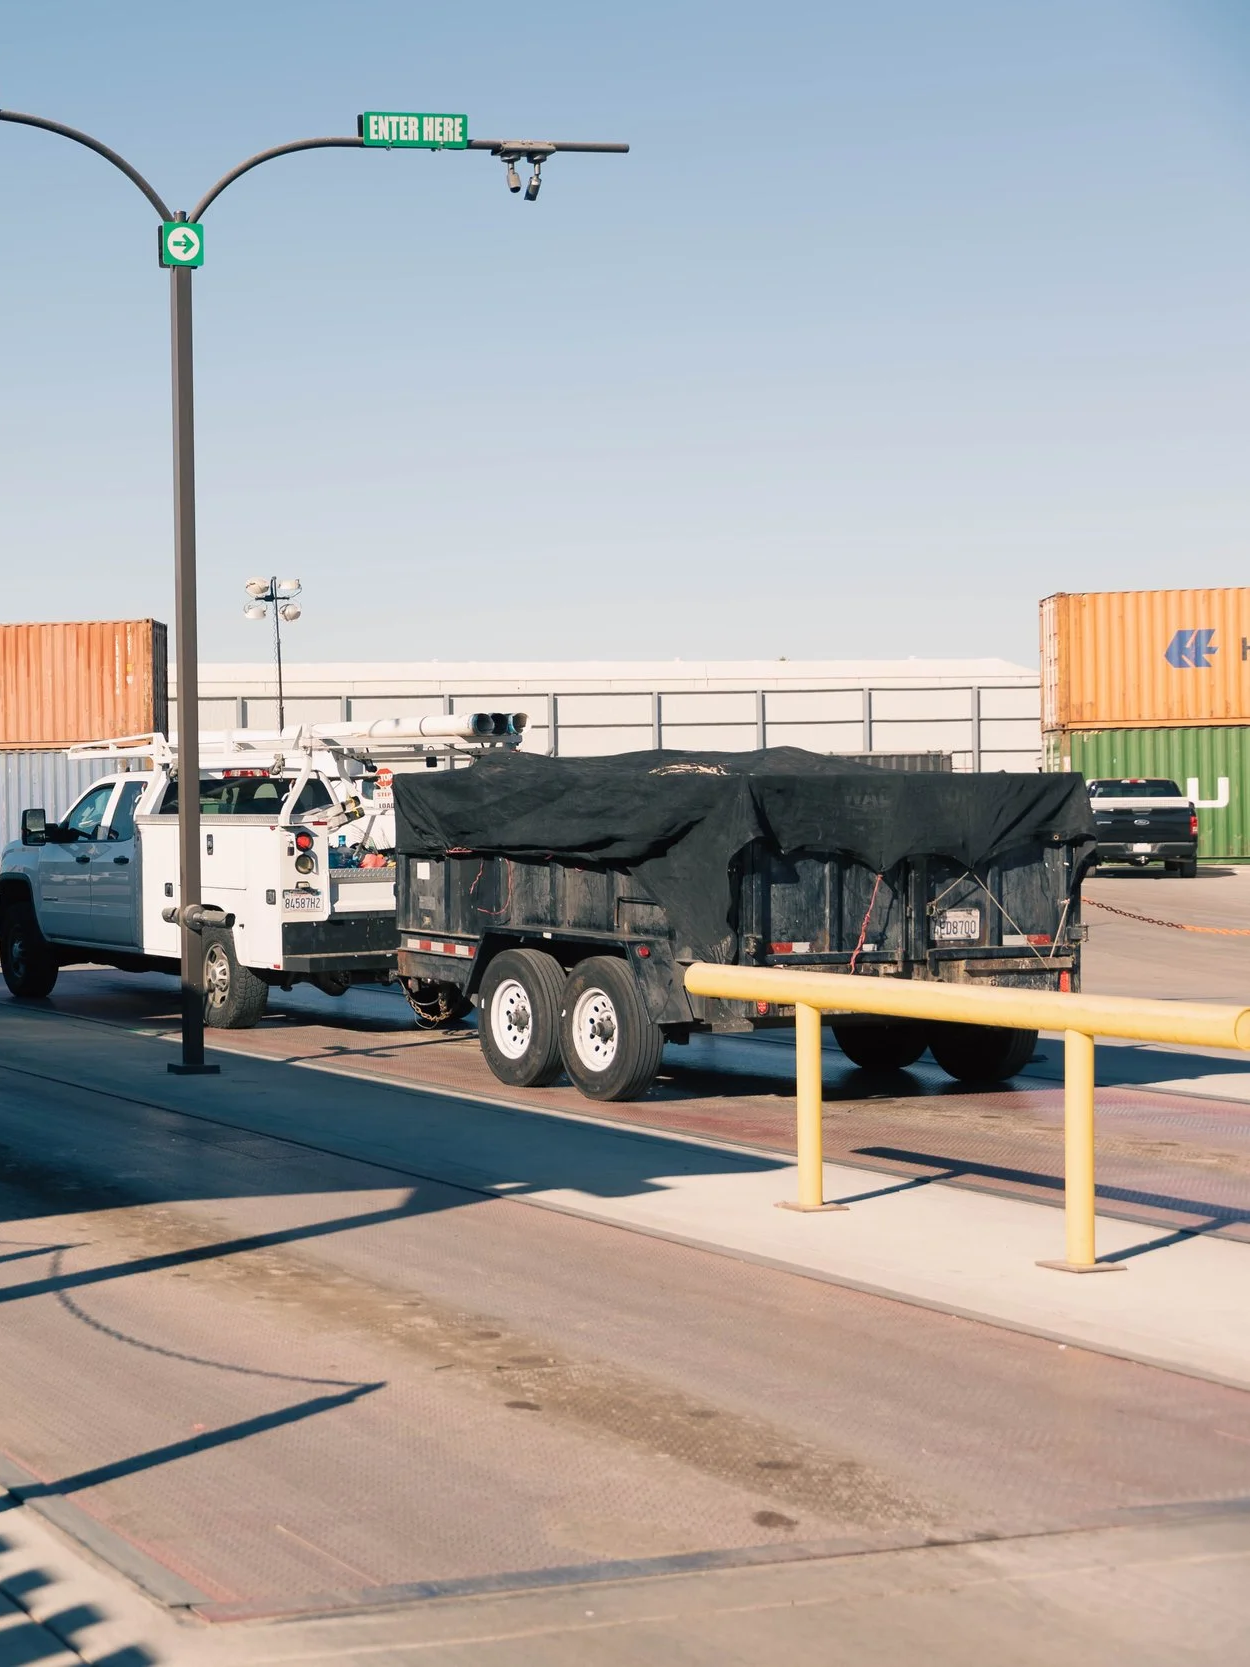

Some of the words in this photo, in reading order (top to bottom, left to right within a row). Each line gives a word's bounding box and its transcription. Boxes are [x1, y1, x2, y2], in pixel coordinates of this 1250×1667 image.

[369, 115, 419, 141] ENTER
[423, 116, 463, 142] HERE
[285, 897, 321, 909] 84587H2
